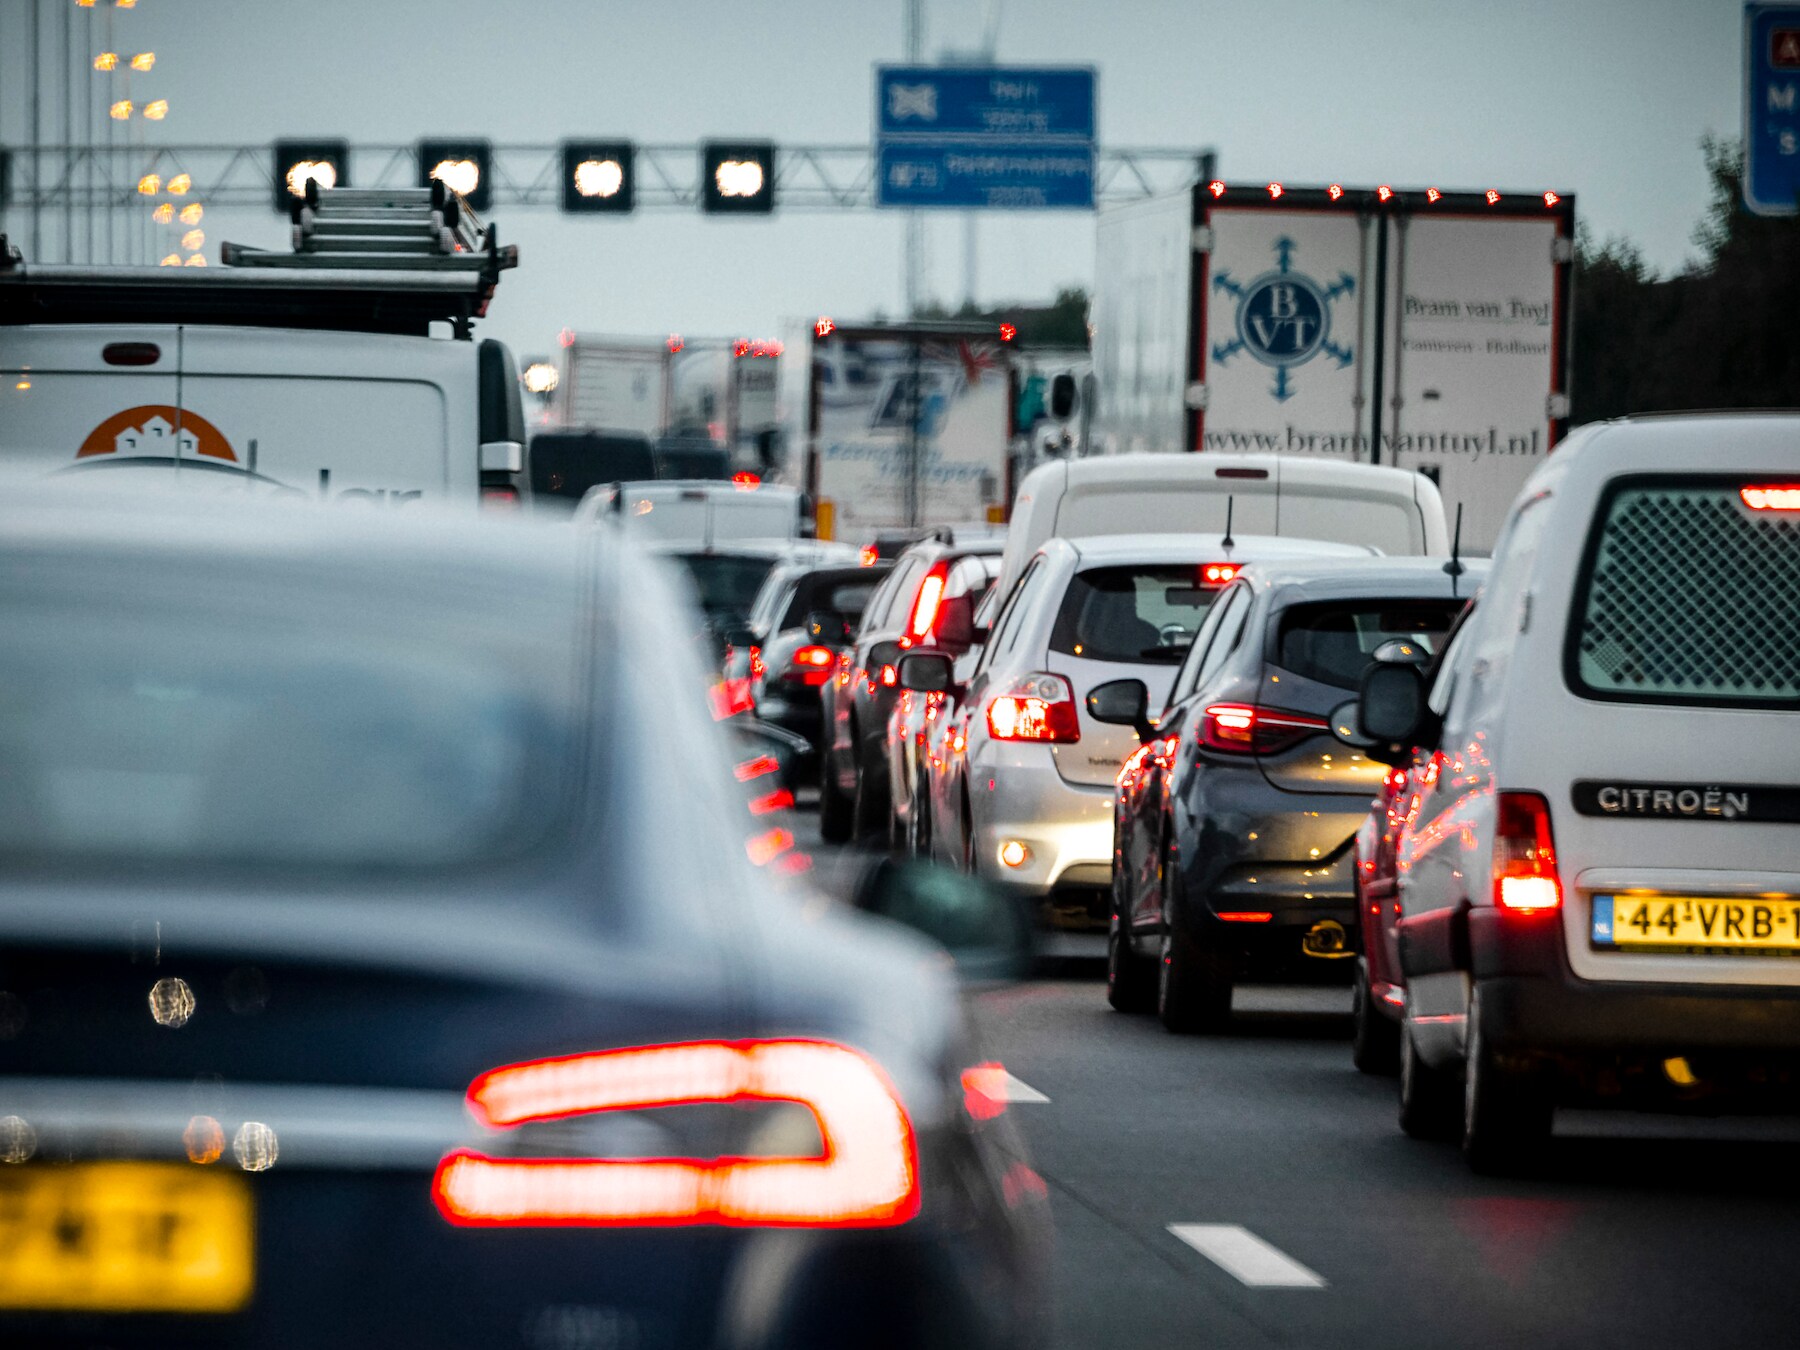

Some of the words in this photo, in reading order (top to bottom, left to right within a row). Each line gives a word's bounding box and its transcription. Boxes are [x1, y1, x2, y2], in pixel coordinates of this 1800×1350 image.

[1271, 285, 1298, 318] B
[1405, 297, 1460, 316] Bram
[1466, 302, 1500, 317] van
[1508, 299, 1550, 325] Tuyl
[1251, 315, 1315, 350] VT
[1598, 785, 1748, 816] CITROËN
